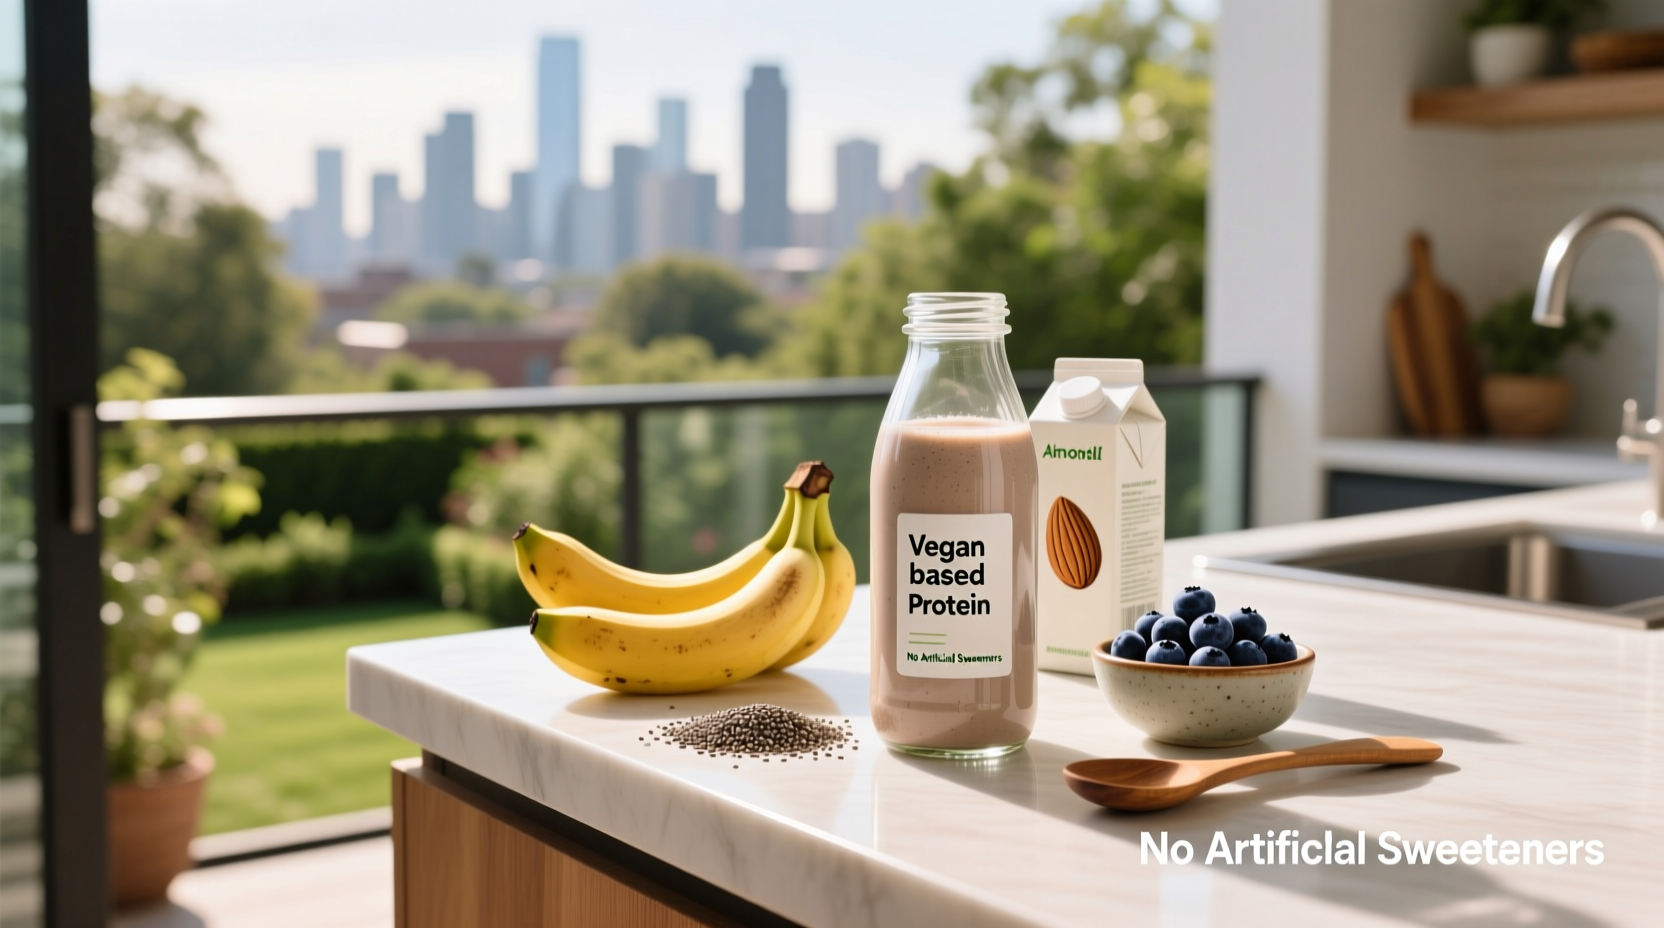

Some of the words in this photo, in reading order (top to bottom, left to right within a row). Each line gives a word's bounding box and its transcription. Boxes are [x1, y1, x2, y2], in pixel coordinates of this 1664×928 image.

[908, 534, 985, 563] Vegan
[910, 562, 985, 585] based
[908, 593, 991, 615] Protein
[907, 652, 919, 661] No
